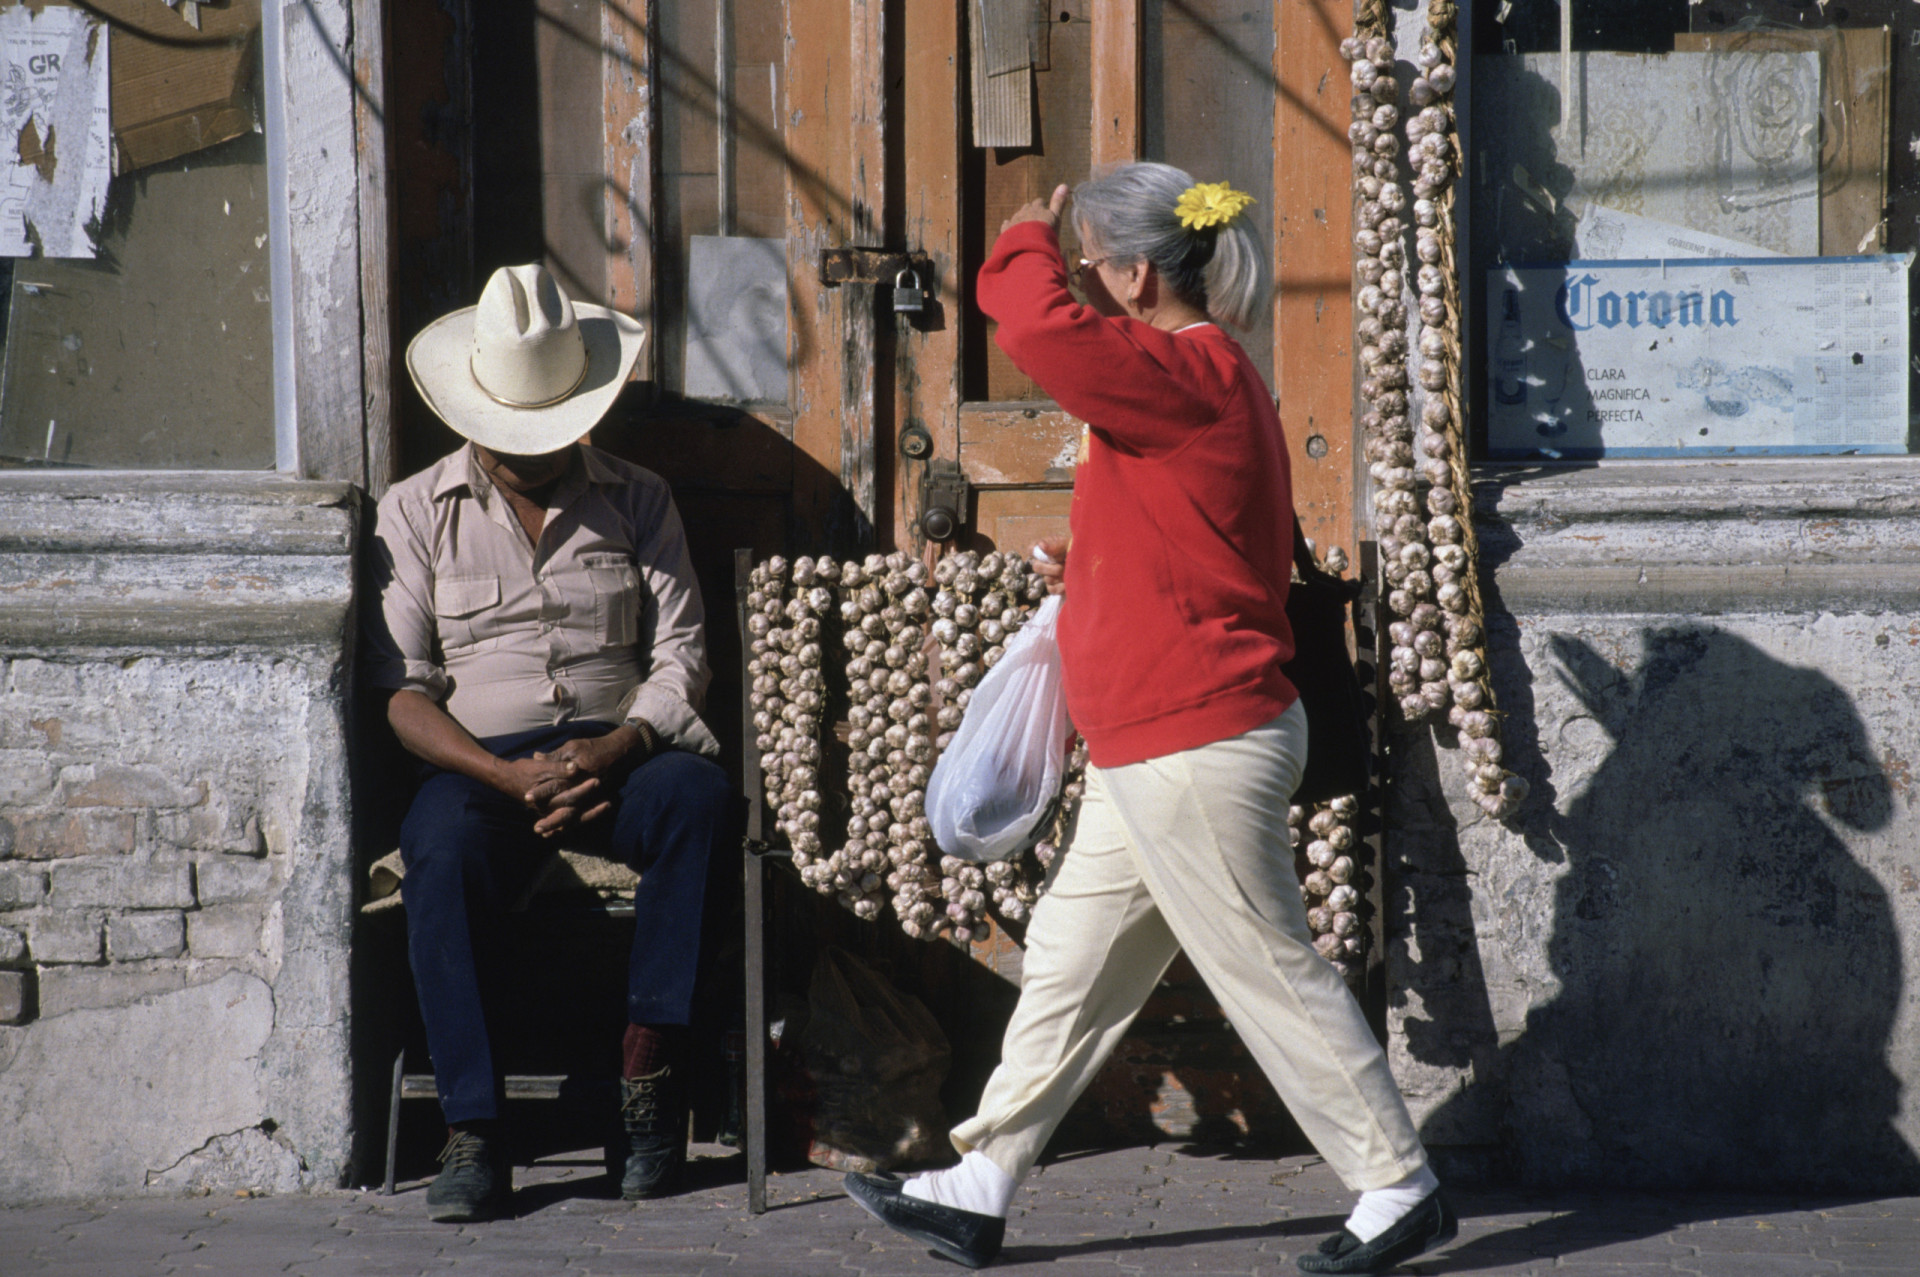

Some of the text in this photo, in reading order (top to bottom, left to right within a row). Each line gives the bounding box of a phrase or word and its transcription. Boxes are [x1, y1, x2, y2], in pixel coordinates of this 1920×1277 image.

[1555, 273, 1740, 331] Corona
[1586, 368, 1626, 381] CLARA
[1586, 388, 1650, 401] MAGNIFICA
[1586, 409, 1644, 423] PERFECTA
